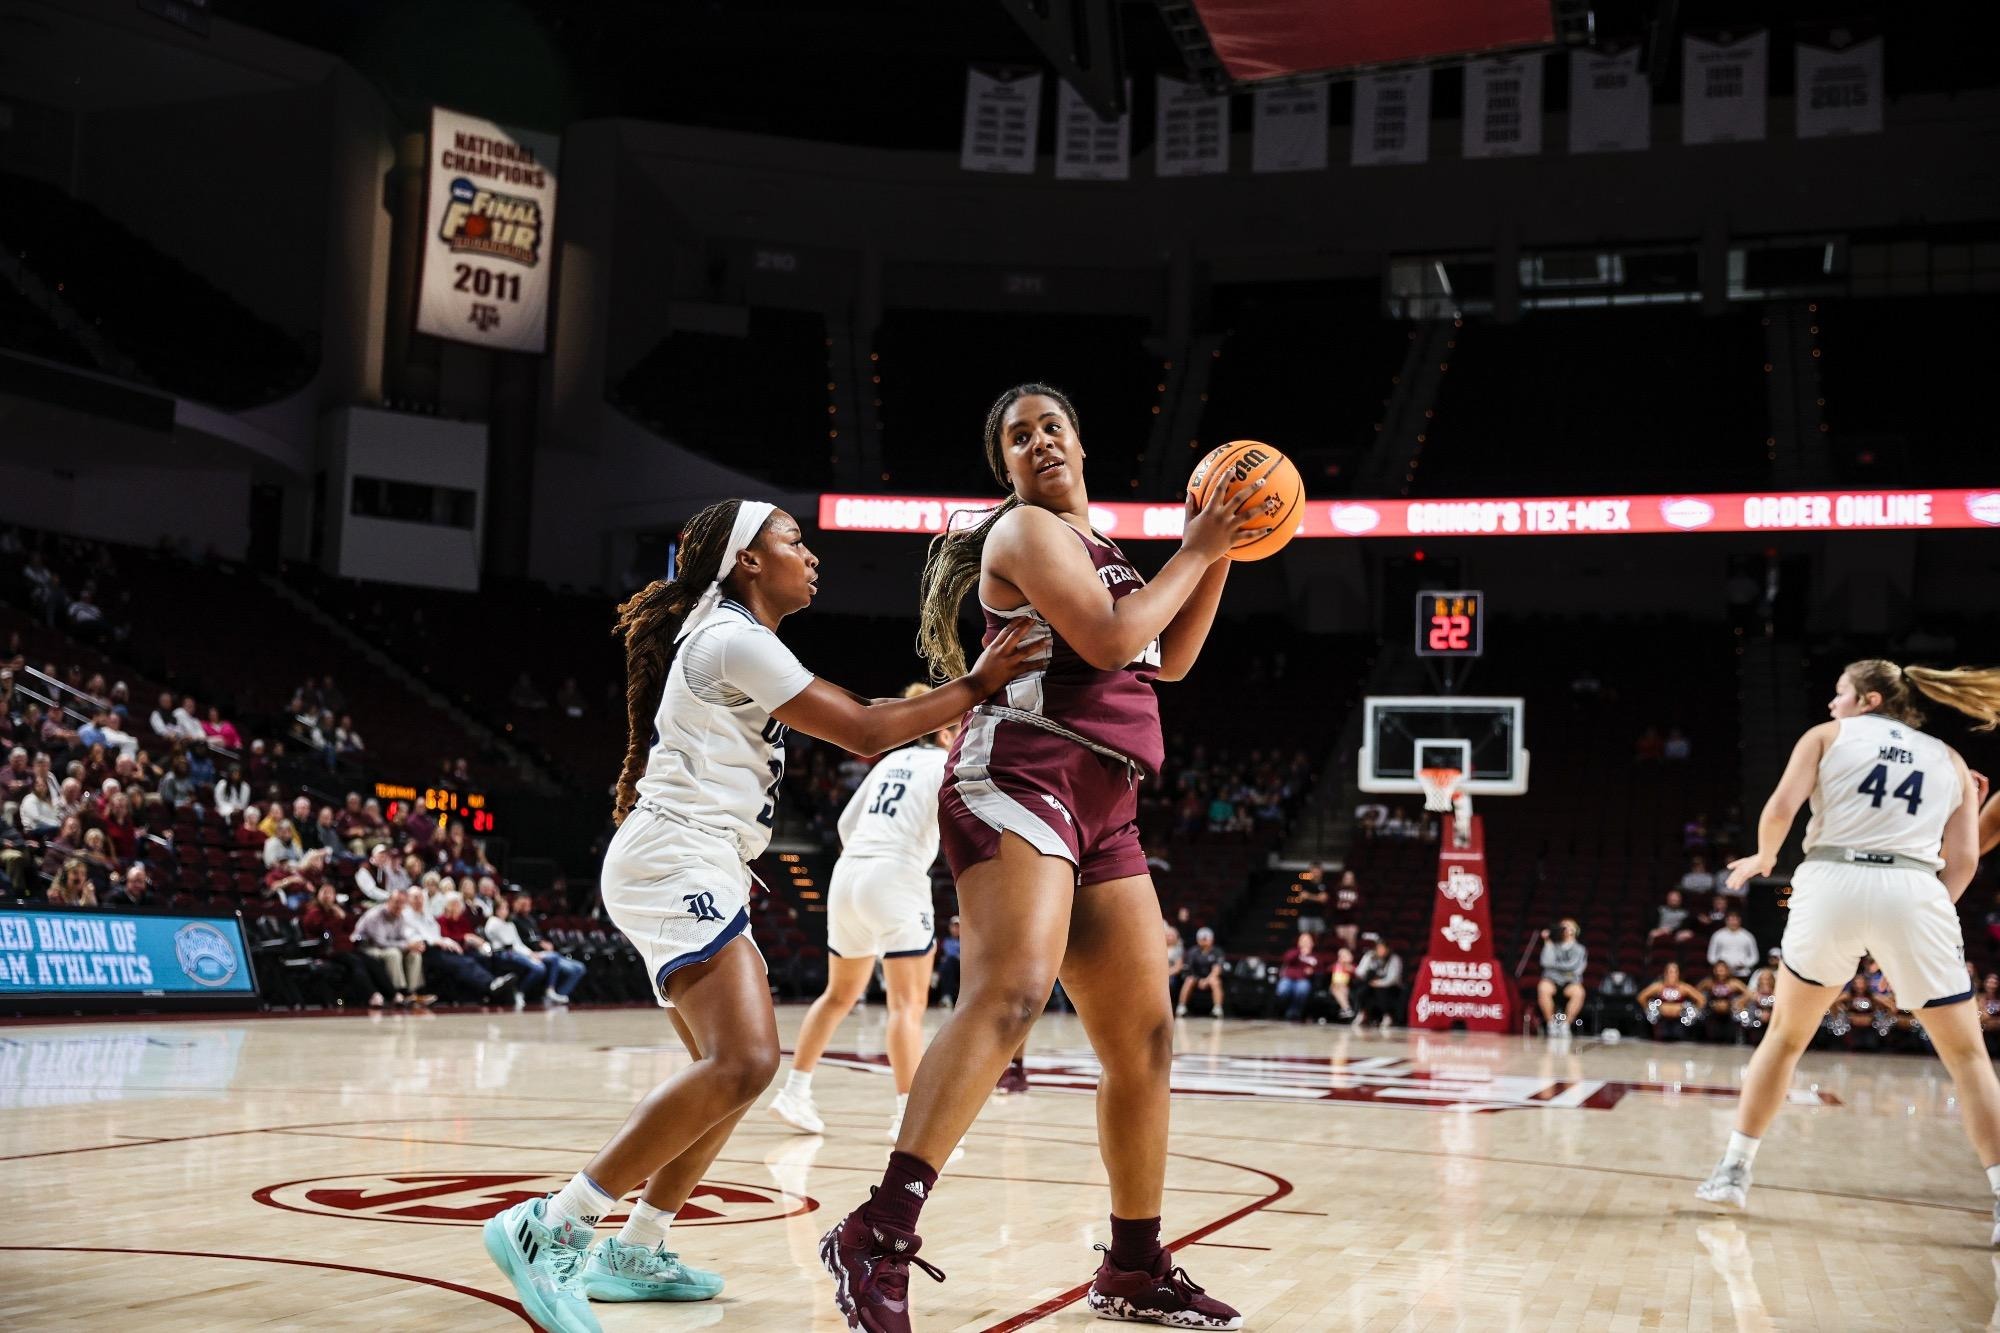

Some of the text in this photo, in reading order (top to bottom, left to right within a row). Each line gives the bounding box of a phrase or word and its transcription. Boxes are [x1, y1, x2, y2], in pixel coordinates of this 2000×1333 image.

[455, 131, 535, 164] NATIONAL
[442, 149, 545, 189] CHAMPIONS
[471, 191, 538, 225] FINAL
[453, 263, 521, 302] 2011
[1407, 501, 1630, 533] GRINGO'S TEX-MEX
[1743, 494, 1933, 528] ORDER ONLINE
[1429, 615, 1470, 650] 22
[1878, 745, 1914, 764] HAYES
[1857, 763, 1925, 816] 44
[0, 917, 137, 953] ED BACON OF
[36, 954, 154, 986] ATHLETICS
[1429, 961, 1493, 980] WELLS
[1430, 979, 1493, 998] FARGO
[904, 1183, 925, 1199] adidas
